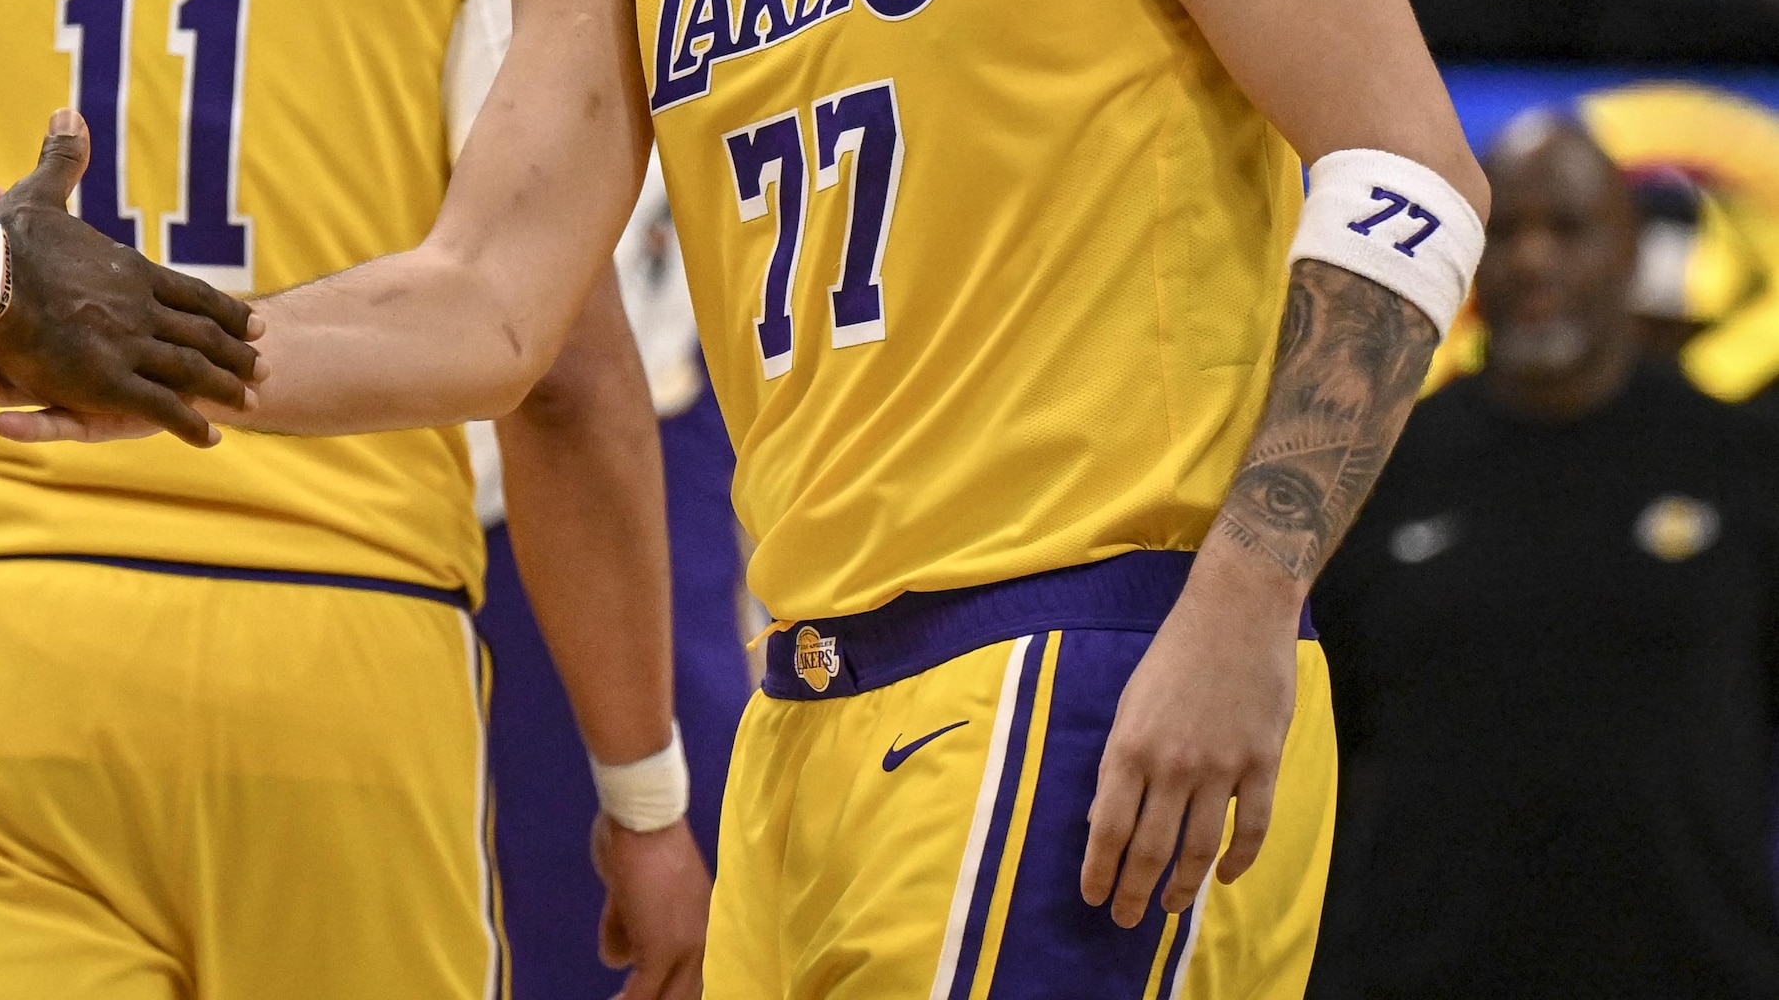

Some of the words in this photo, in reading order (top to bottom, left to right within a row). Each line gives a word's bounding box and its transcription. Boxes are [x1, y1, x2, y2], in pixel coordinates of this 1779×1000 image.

[721, 77, 906, 382] 77
[1347, 186, 1441, 258] 77
[796, 645, 837, 675] LAKERS
